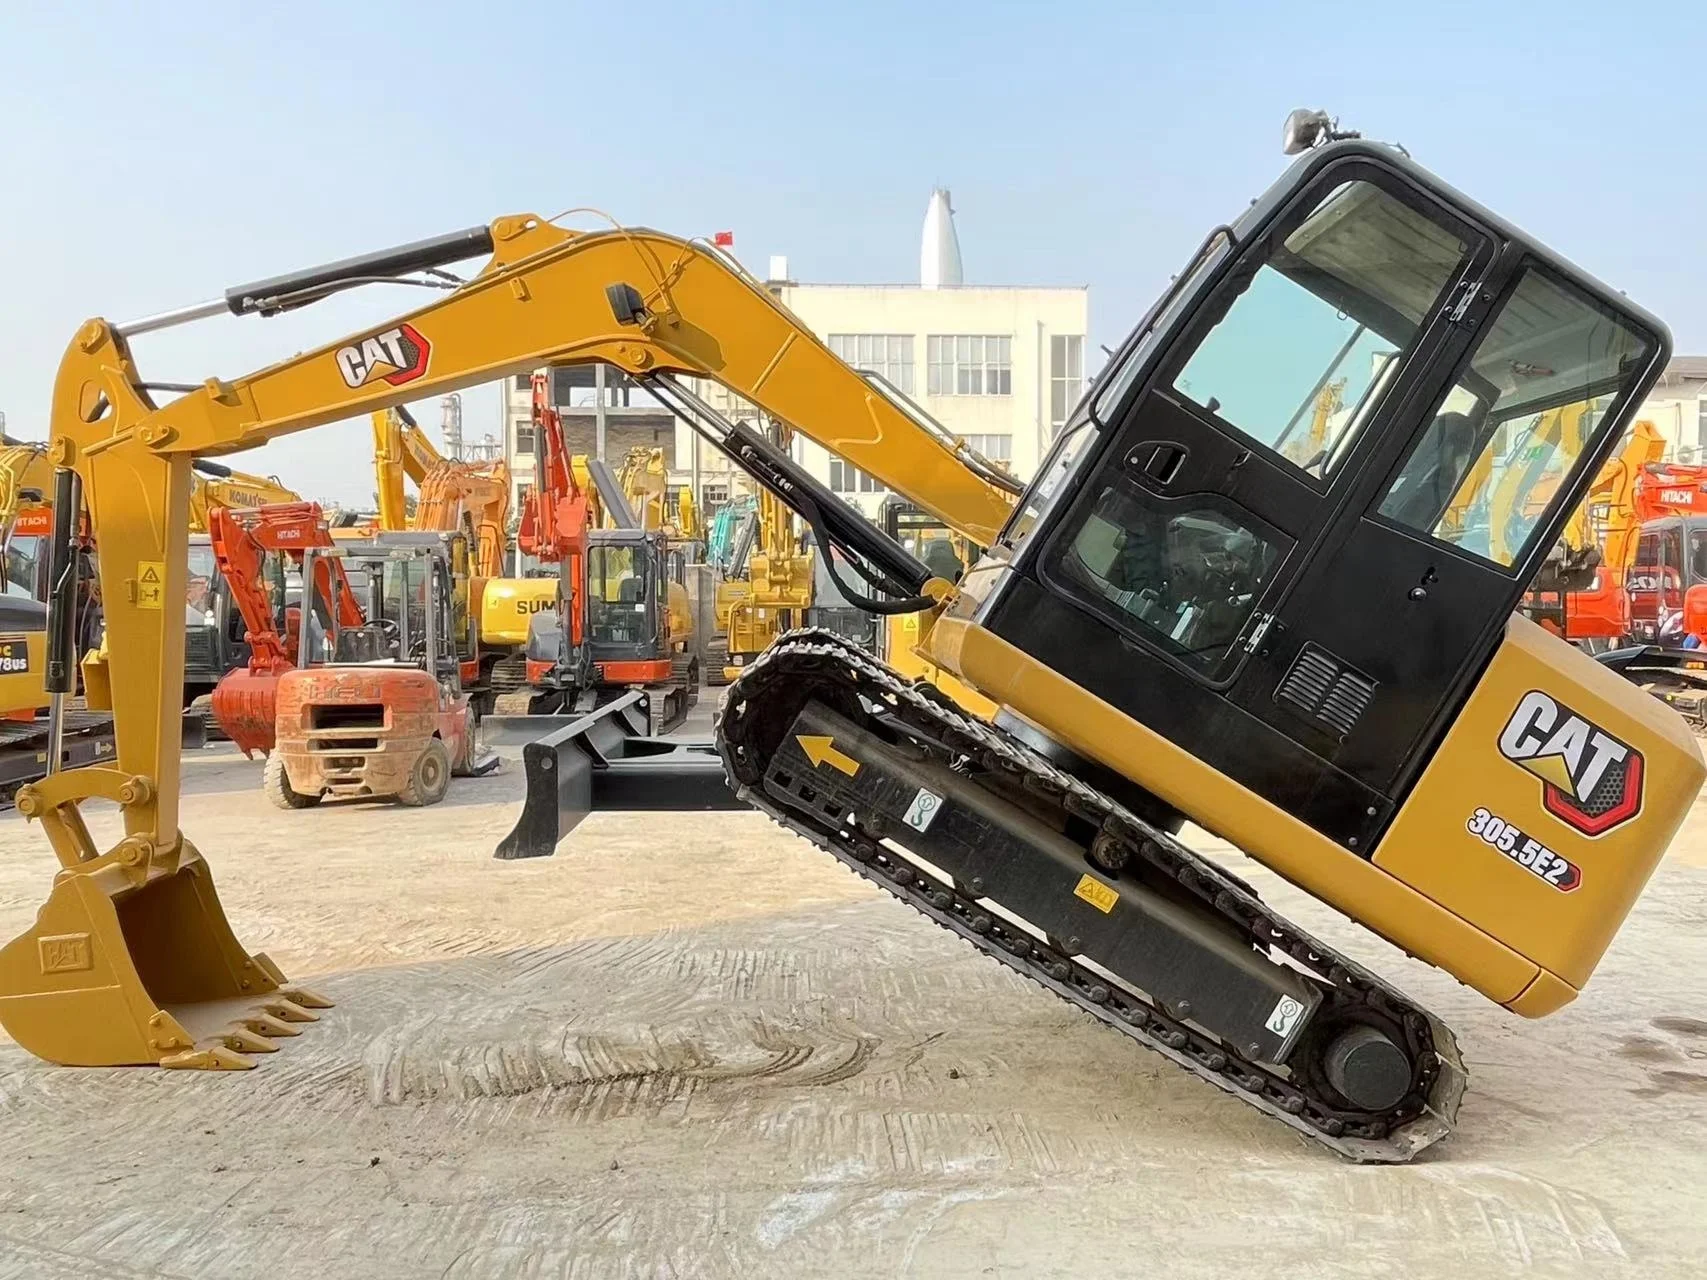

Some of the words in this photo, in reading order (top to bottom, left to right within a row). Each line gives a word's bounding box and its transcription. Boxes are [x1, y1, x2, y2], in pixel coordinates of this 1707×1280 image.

[336, 328, 407, 387] CAT
[1661, 490, 1693, 504] HITACHI
[1500, 691, 1628, 803] CAT
[1468, 807, 1568, 886] 305.5E2
